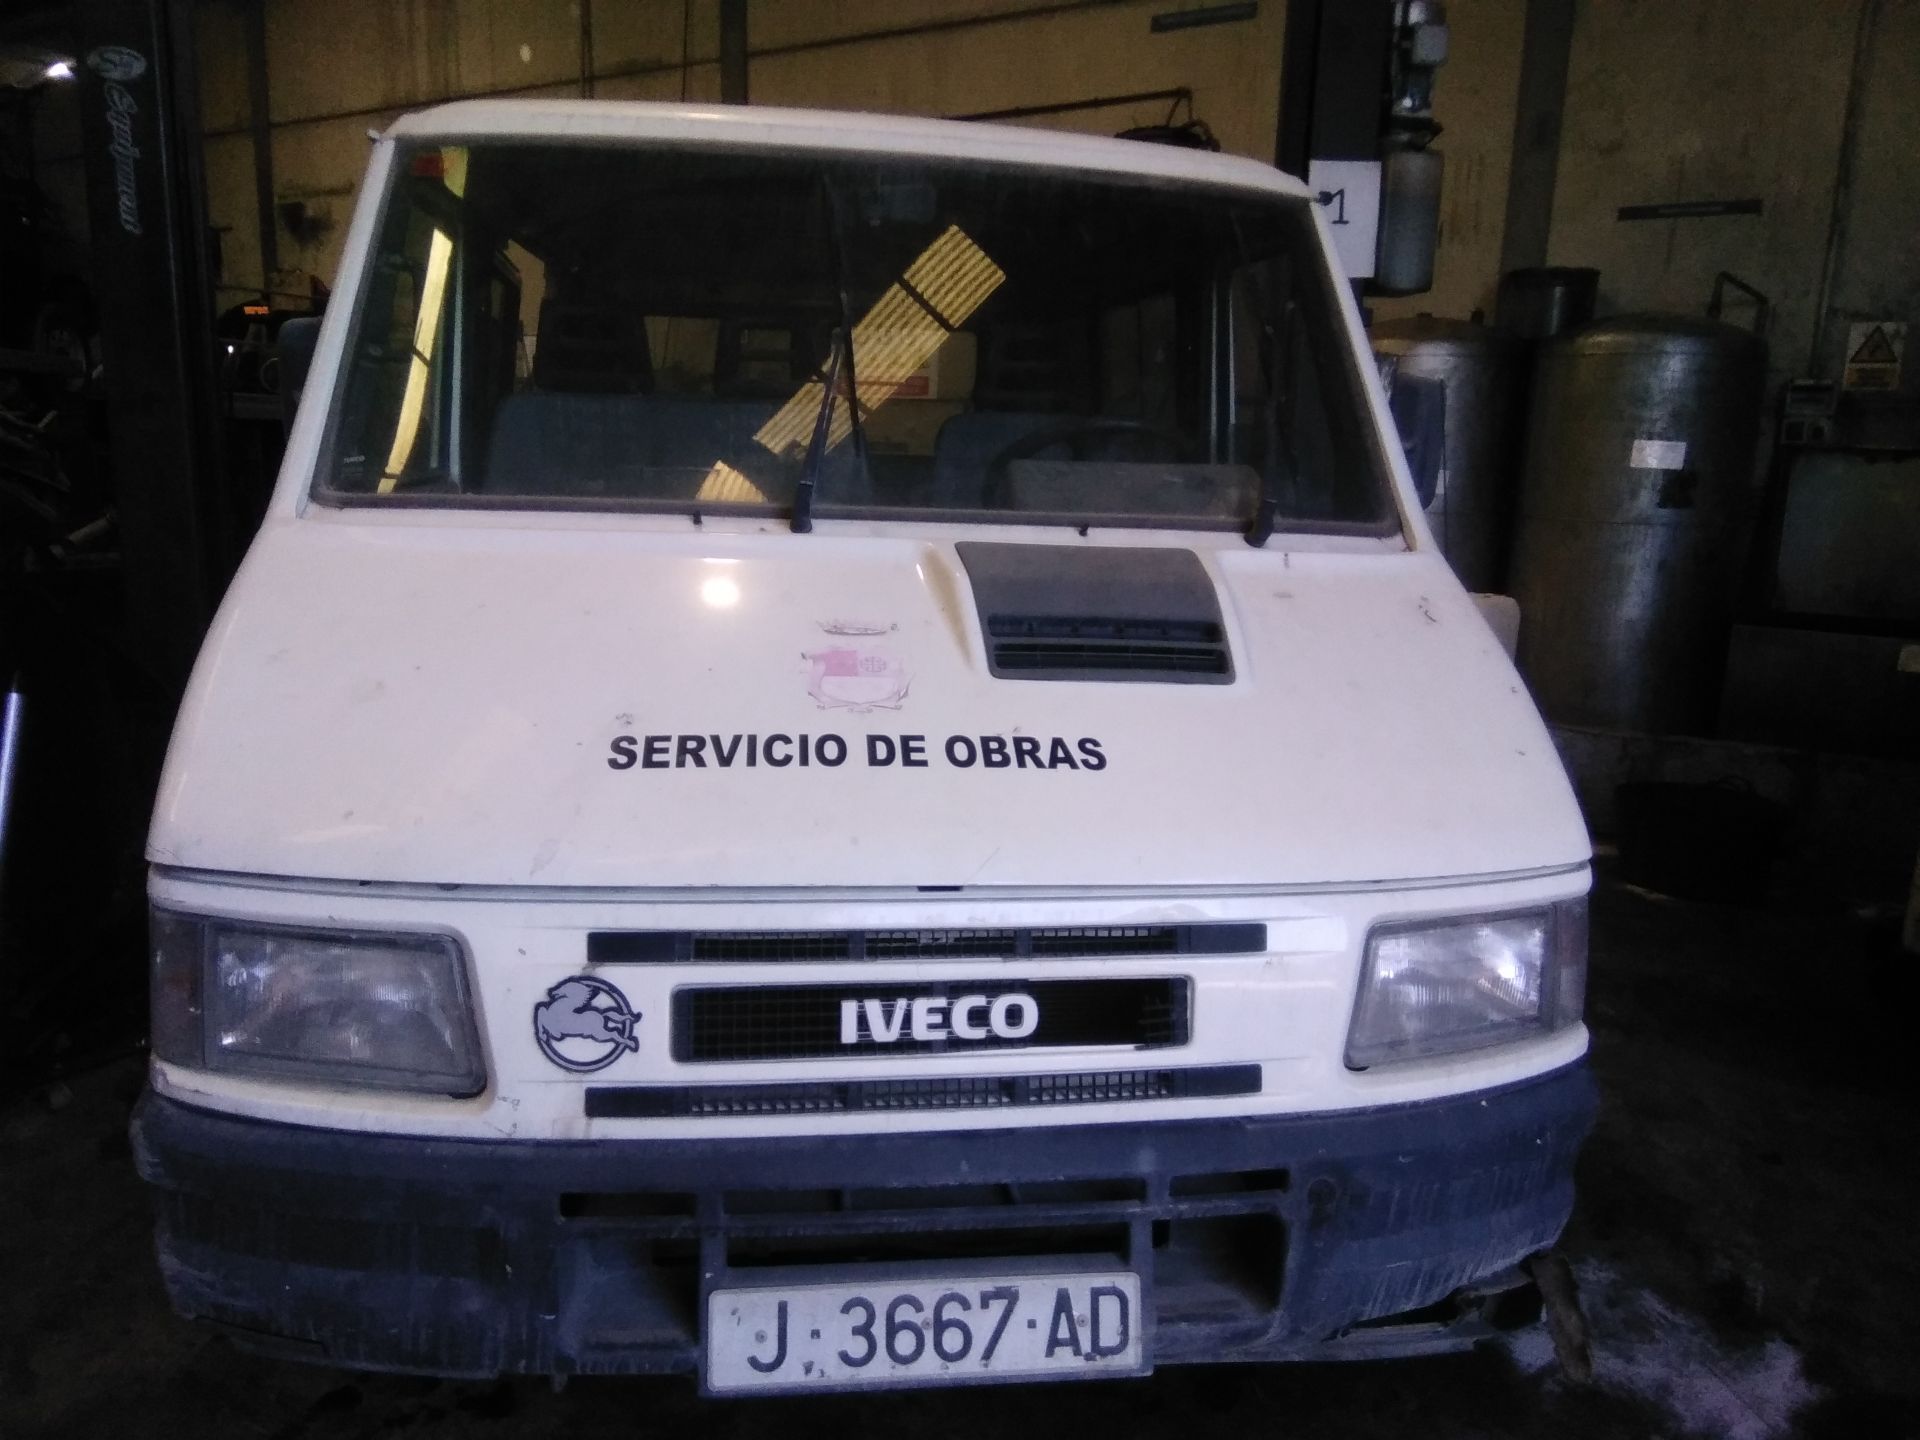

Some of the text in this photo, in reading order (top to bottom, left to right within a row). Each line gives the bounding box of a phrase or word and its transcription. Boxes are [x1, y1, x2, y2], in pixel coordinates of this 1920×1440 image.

[607, 733, 1108, 772] SERVICIO DE OBRAS
[840, 992, 1040, 1044] IVECO
